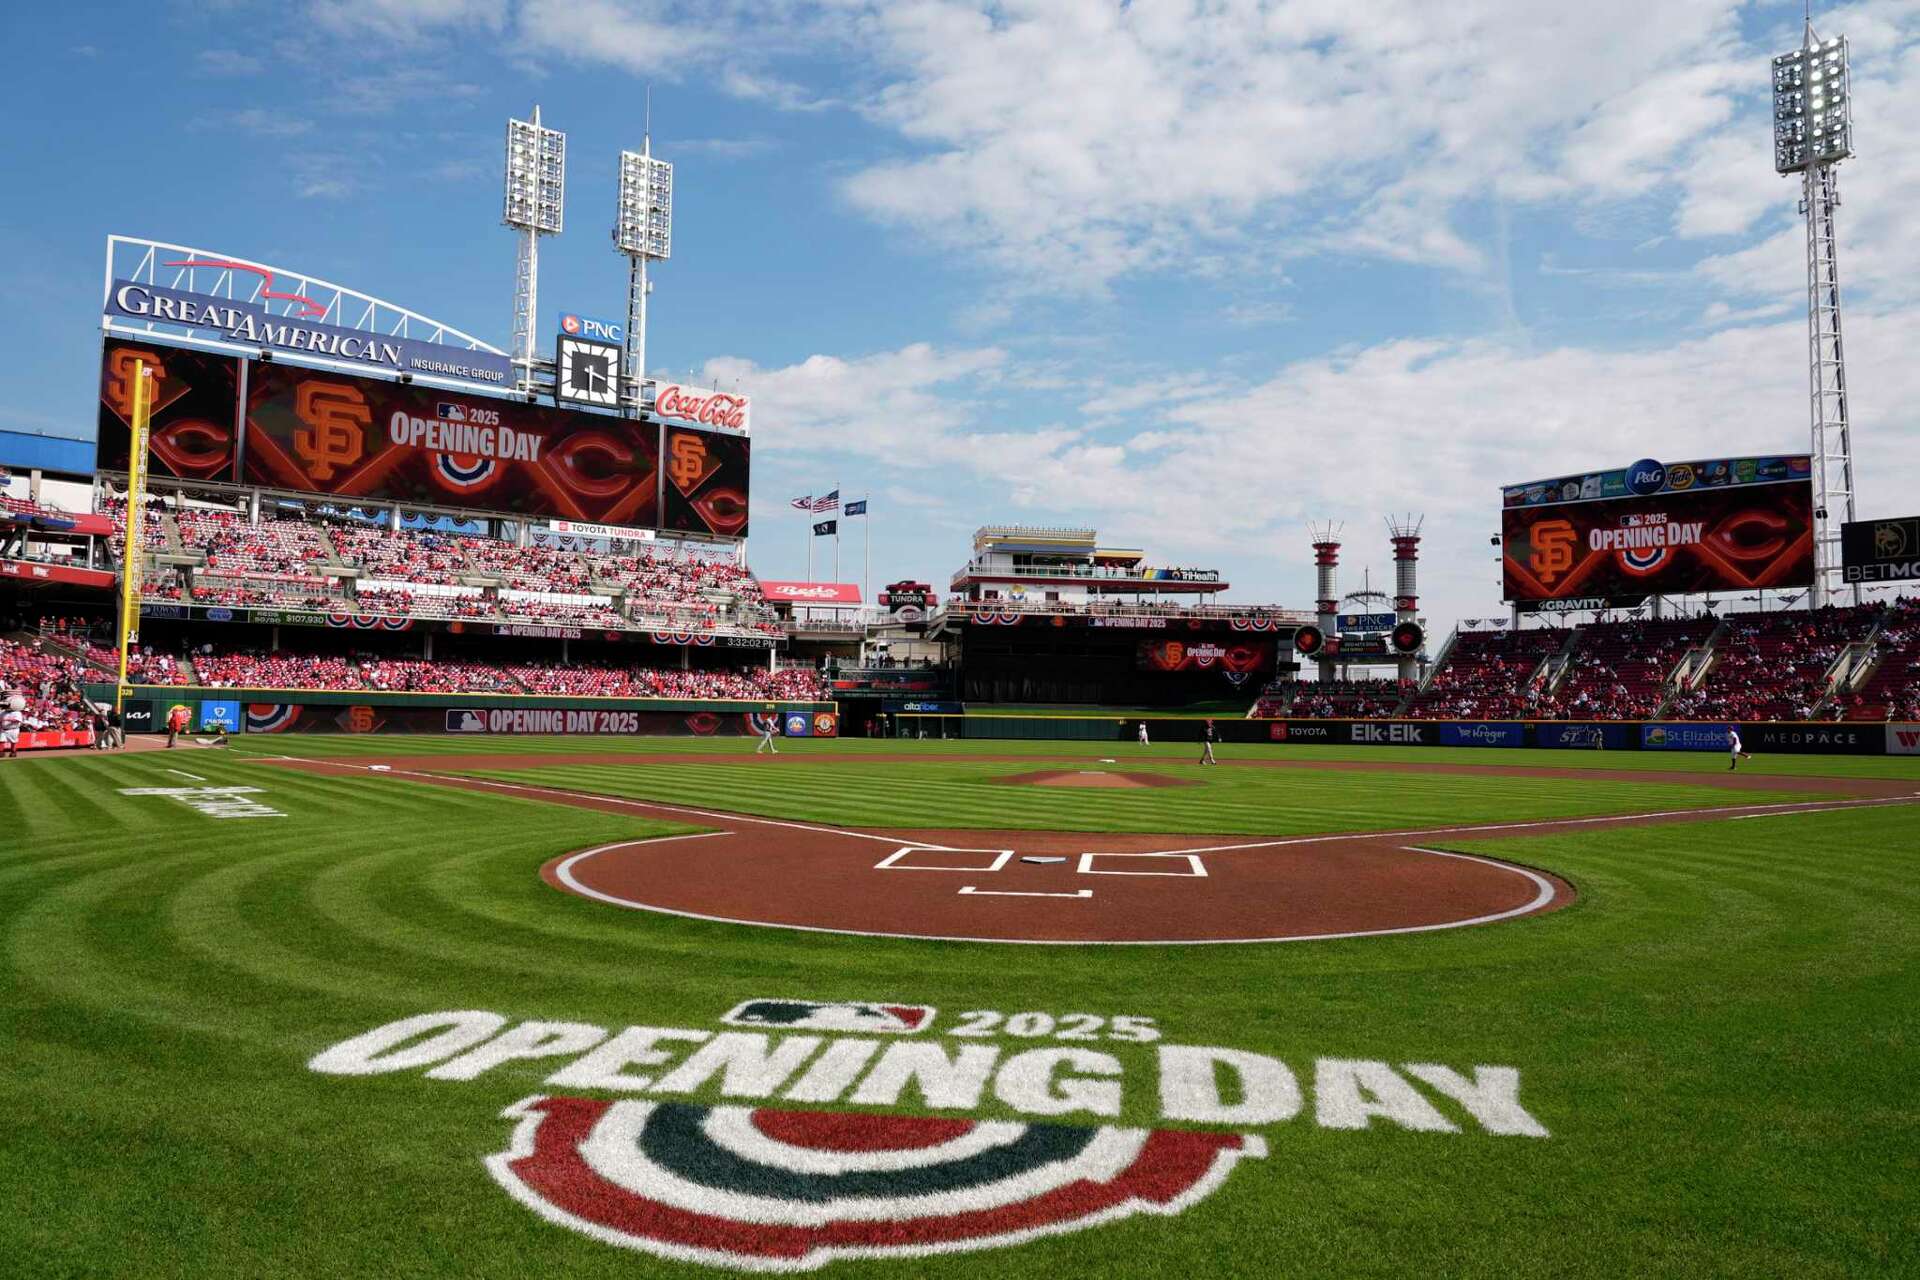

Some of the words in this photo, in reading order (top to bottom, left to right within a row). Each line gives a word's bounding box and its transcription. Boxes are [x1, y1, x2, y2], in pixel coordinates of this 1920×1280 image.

[116, 285, 242, 330] GREAT
[410, 357, 469, 377] INSURANCE
[471, 366, 504, 382] GROUP
[582, 319, 621, 341] PNC
[655, 384, 746, 430] Coca-Cola
[470, 408, 499, 425] 2025
[390, 411, 494, 456] OPENING
[498, 426, 543, 462] DAY
[1634, 469, 1662, 484] P&G
[1644, 513, 1667, 525] 2025
[572, 523, 607, 534] TOYOTA
[609, 527, 646, 539] TUNDRA
[1589, 525, 1665, 551] OPENING
[1667, 522, 1702, 545] DAY
[1181, 570, 1218, 582] TriHealth
[890, 595, 924, 604] TUNDRA
[1545, 598, 1606, 611] GRAVITY
[1358, 615, 1385, 625] PNC
[512, 626, 545, 637] OPENING
[546, 627, 562, 639] DAY
[563, 628, 581, 640] 2025
[727, 637, 760, 649] 3:32:02
[762, 639, 777, 650] PM
[490, 709, 562, 733] OPENING
[566, 711, 599, 733] DAY
[600, 712, 639, 733] 2025
[1289, 727, 1328, 737] TOYOTA
[1472, 725, 1507, 743] Kroger
[1683, 730, 1727, 742] Elizabe
[1763, 732, 1857, 744] MEDPACE
[949, 1010, 1162, 1042] 2025
[307, 1009, 1122, 1117] OPENING
[1157, 1044, 1551, 1138] DAY
